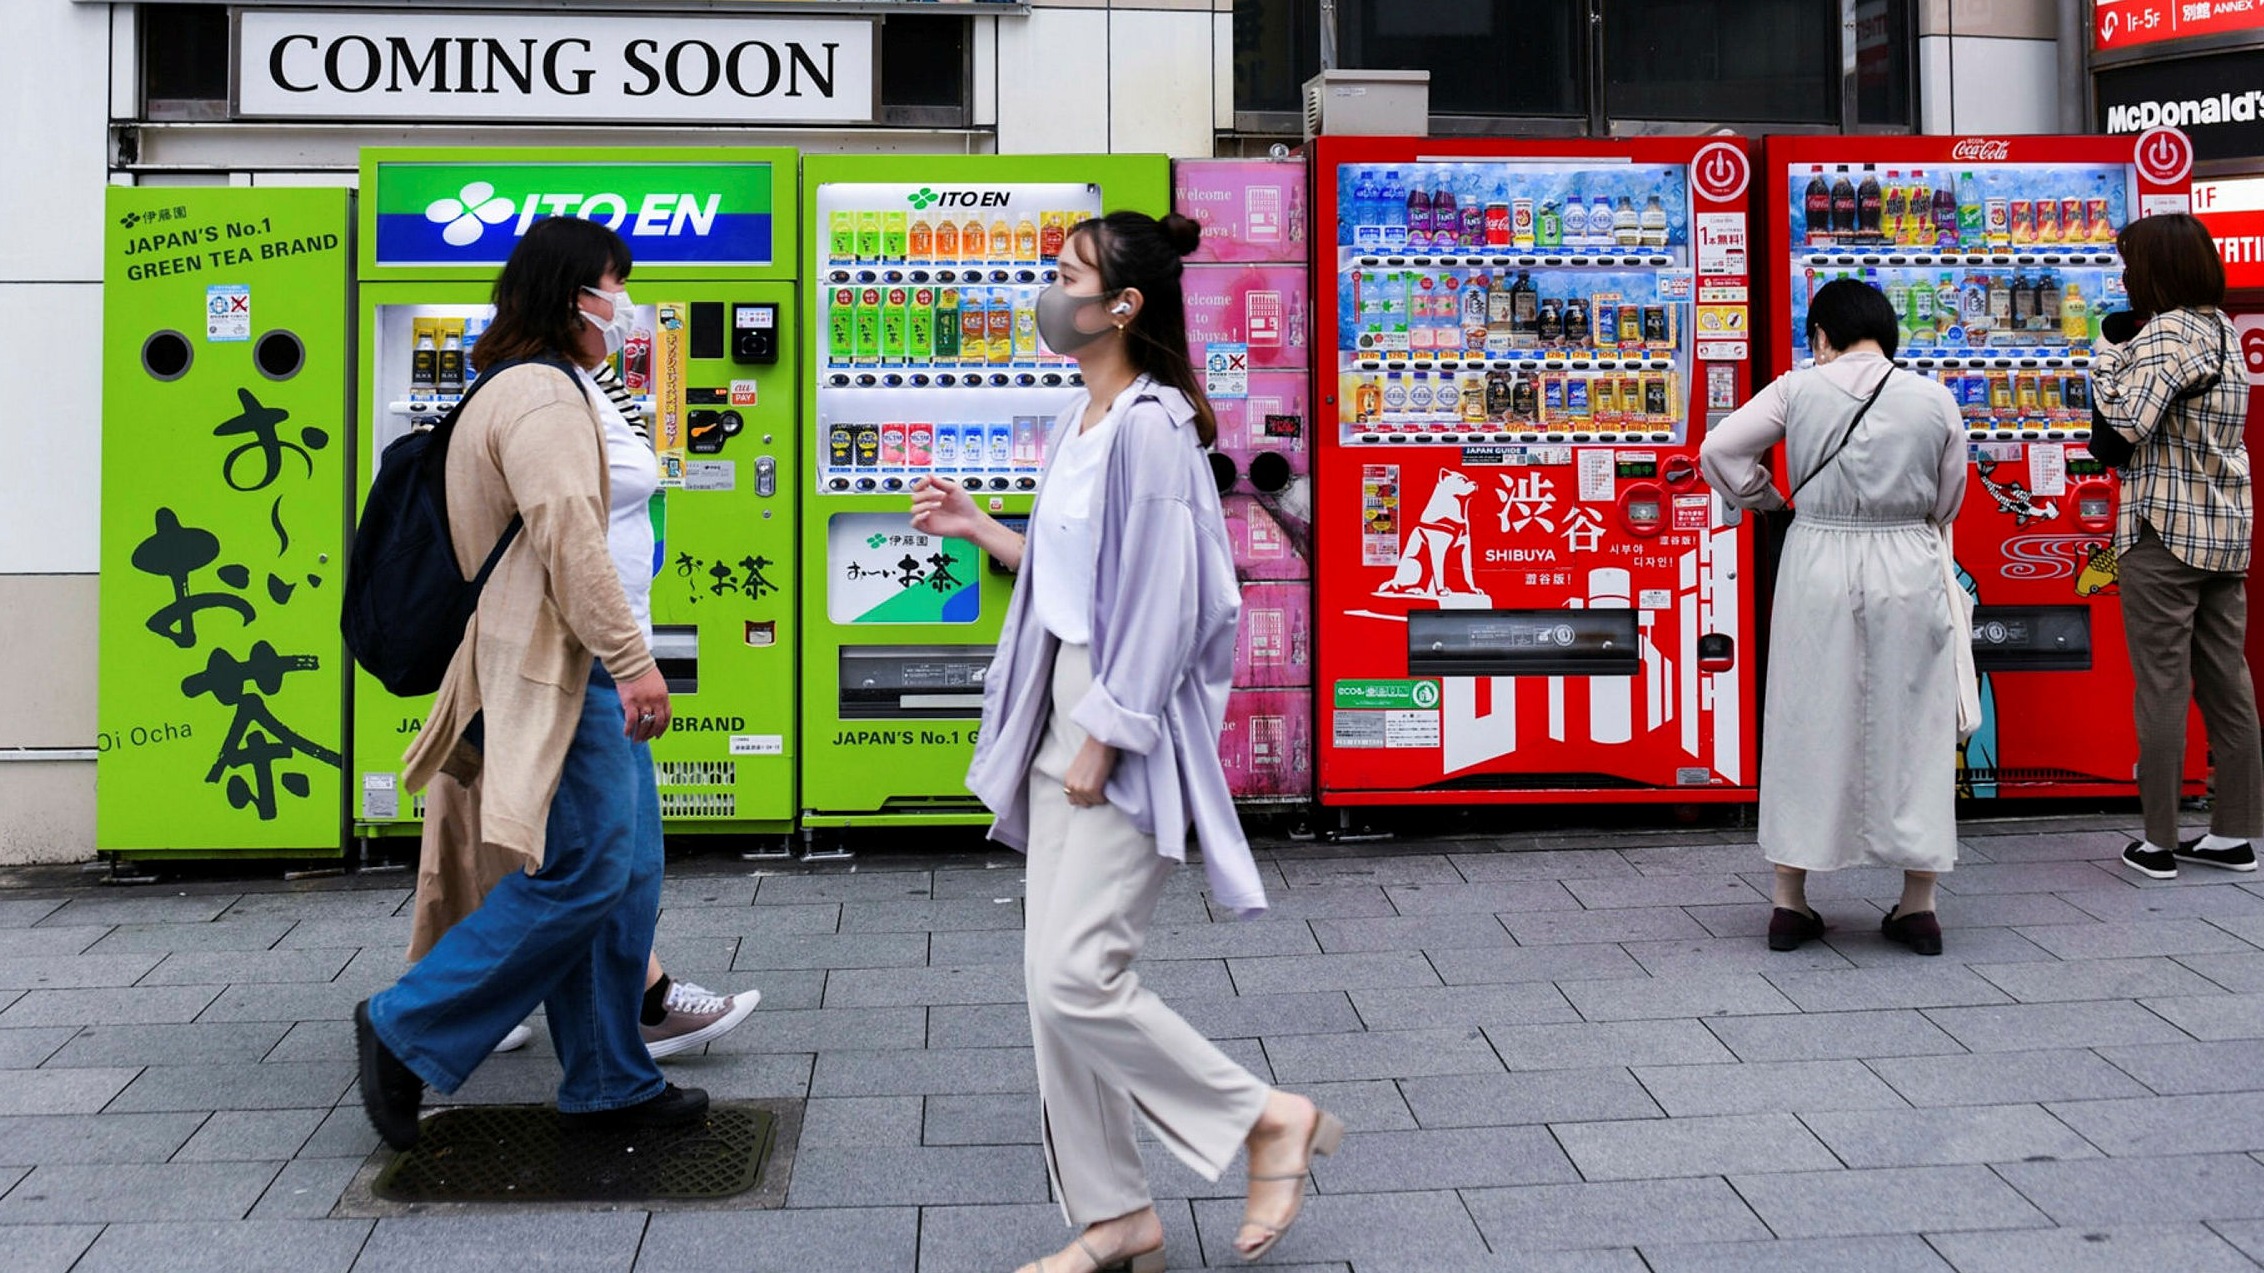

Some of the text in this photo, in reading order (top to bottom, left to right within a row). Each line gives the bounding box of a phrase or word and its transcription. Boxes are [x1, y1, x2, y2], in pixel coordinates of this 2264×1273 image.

[2182, 0, 2253, 22] 別館 ANNEX
[2127, 8, 2161, 33] 1F-5F
[268, 34, 839, 100] COMING SOON
[1952, 139, 2011, 161] Coca-Cola
[938, 191, 1010, 207] ITO EN
[1175, 187, 1232, 201] Welcome
[2195, 186, 2217, 208] 1F
[142, 206, 187, 225] 伊藤園
[513, 193, 722, 236] ITO EN
[1194, 207, 1209, 219] to
[124, 217, 271, 255] JAPAN'S No.1
[127, 233, 338, 281] GREEN TEA BRAND
[1186, 292, 1232, 305] elcome
[1195, 312, 1209, 323] to
[1494, 471, 1607, 553] 渋谷
[889, 535, 929, 548] 伊藤園
[1609, 544, 1644, 555] 시부야
[1485, 550, 1556, 562] SHIBUYA
[1633, 557, 1673, 569] 디자인!
[672, 717, 745, 732] BRAND
[130, 721, 193, 748] Ocha
[833, 731, 914, 746] JAPAN'S
[921, 731, 959, 746] No.1
